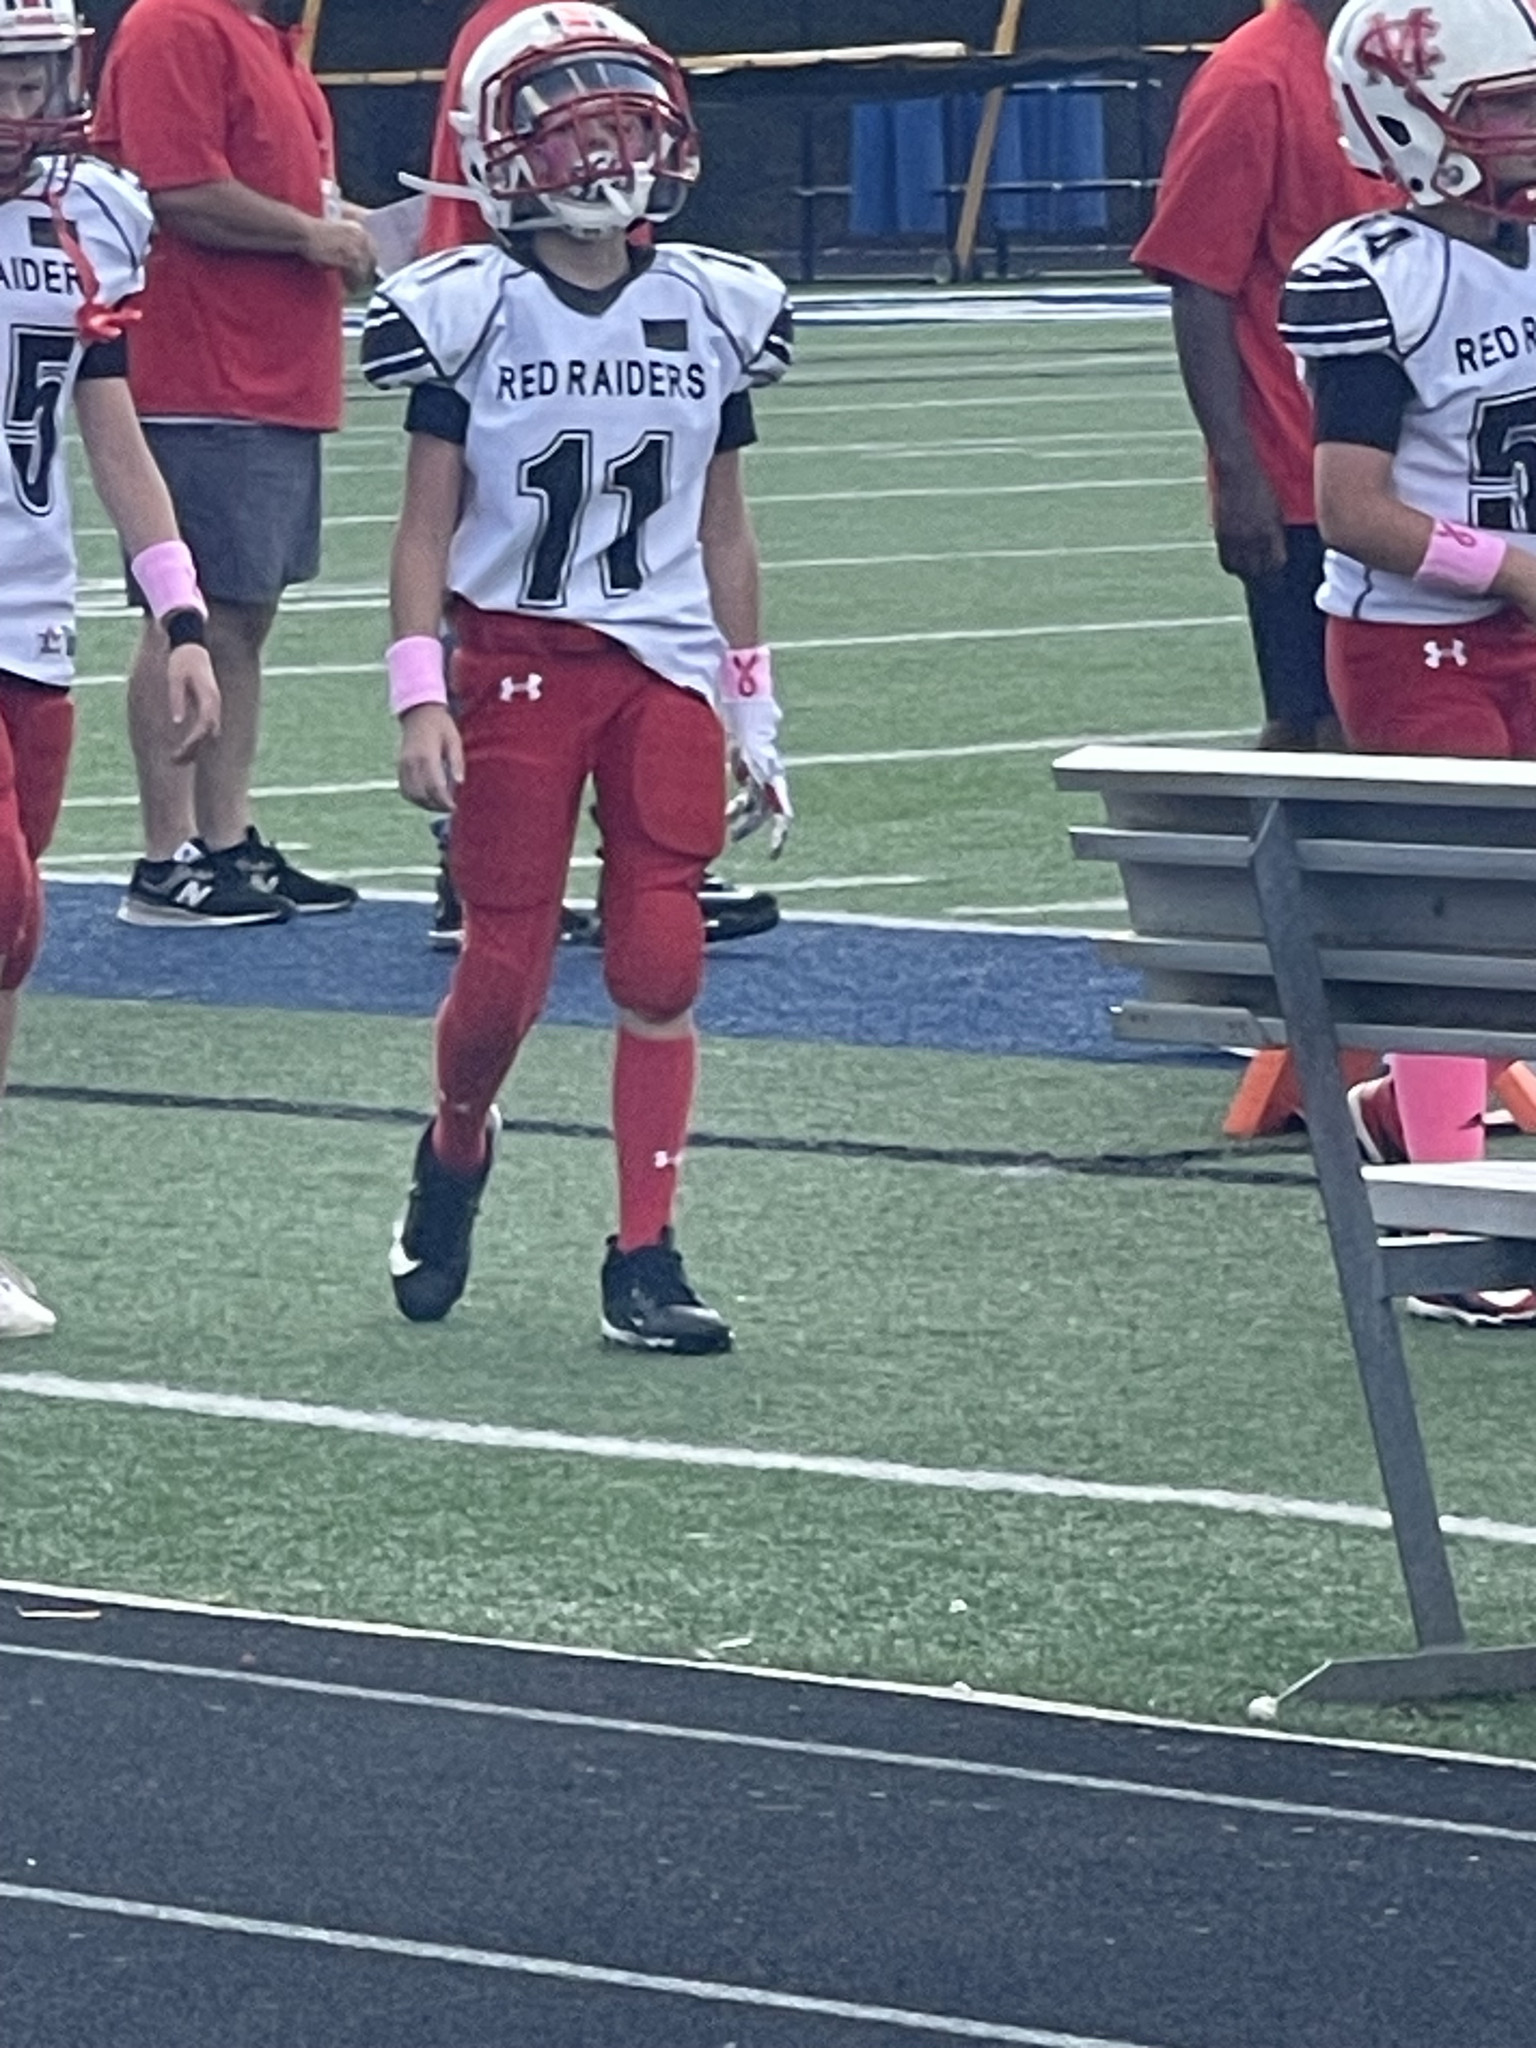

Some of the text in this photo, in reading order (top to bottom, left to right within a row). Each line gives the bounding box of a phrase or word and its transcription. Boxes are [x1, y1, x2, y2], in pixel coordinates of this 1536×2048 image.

[0, 256, 86, 296] AIDER
[1454, 325, 1520, 375] RED
[496, 359, 707, 400] RED RAIDERS
[3, 322, 80, 517] 5
[516, 428, 673, 609] 11
